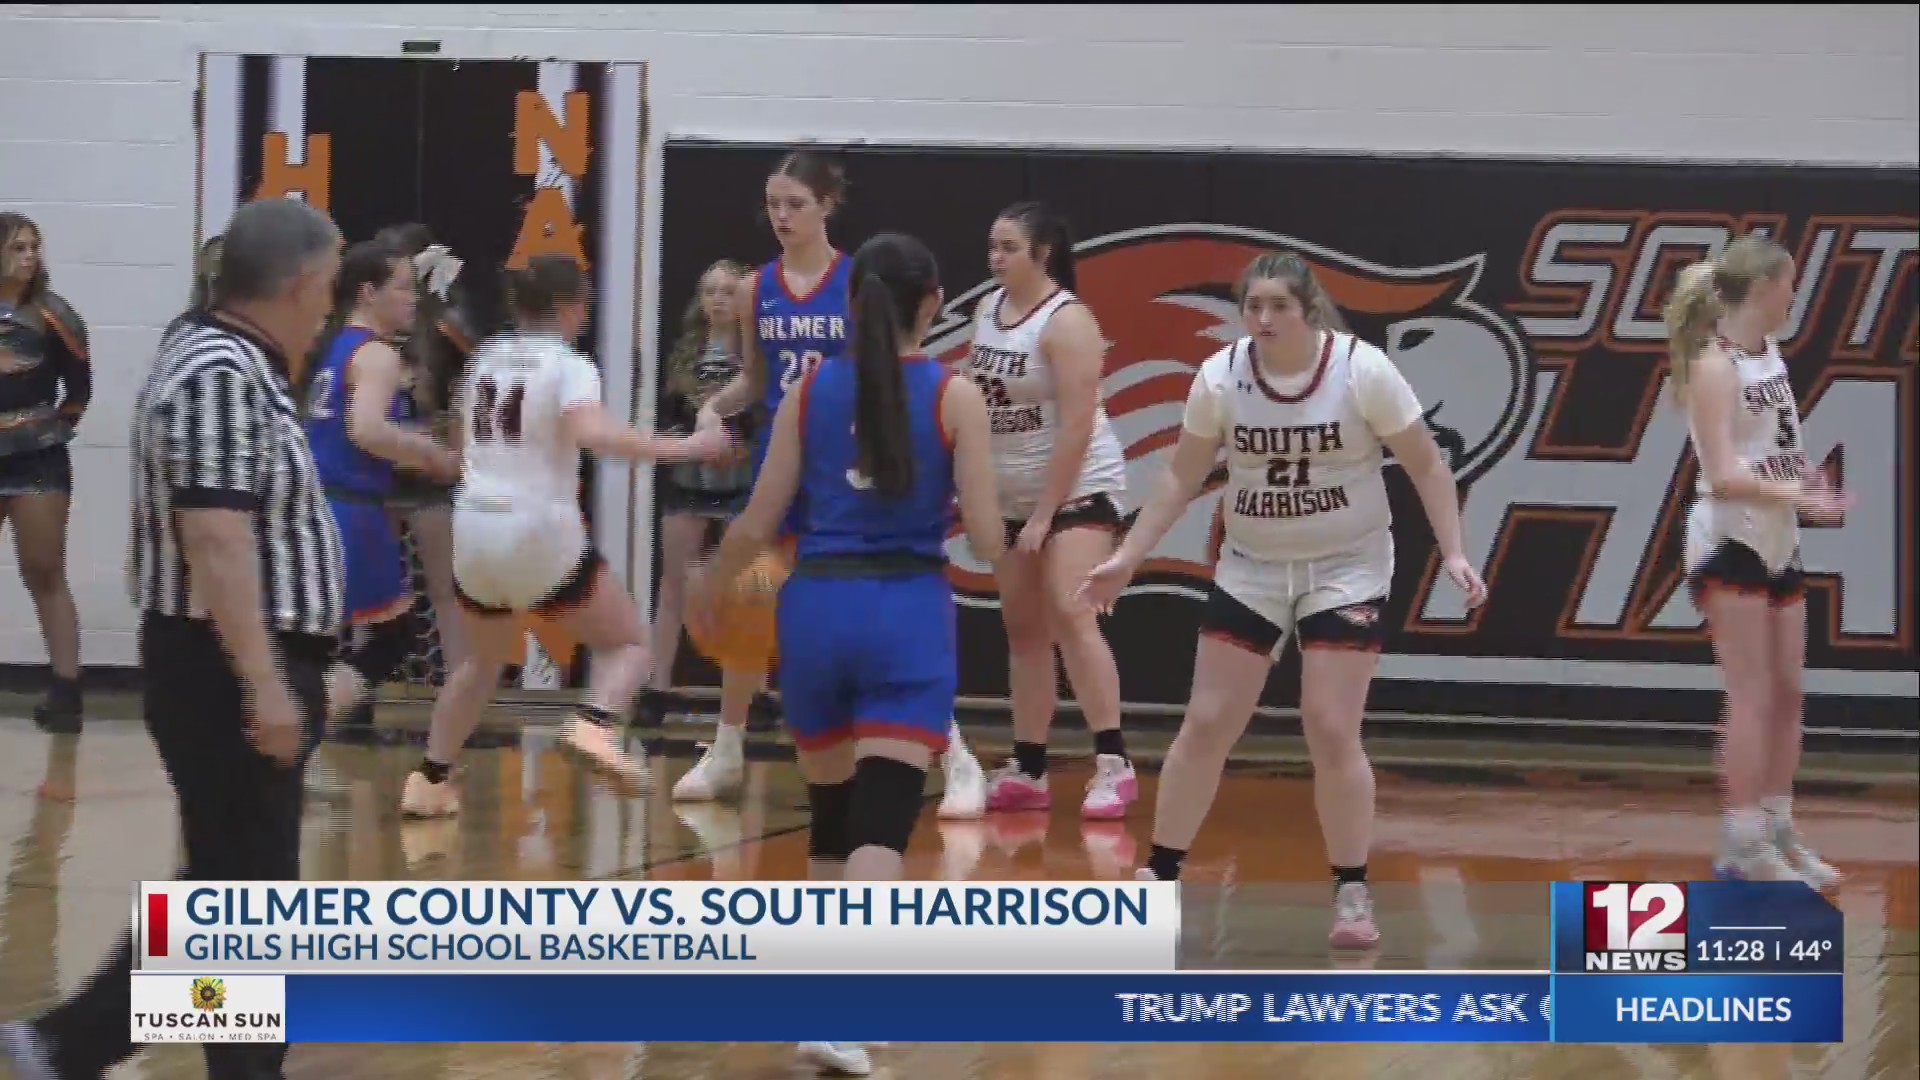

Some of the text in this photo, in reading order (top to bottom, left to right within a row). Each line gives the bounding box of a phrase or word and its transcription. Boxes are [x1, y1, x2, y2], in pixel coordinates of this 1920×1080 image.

[1517, 209, 1919, 355] SOUT
[758, 314, 846, 340] GILMER
[1234, 420, 1343, 455] SOUTH
[1266, 457, 1311, 488] 21
[1234, 486, 1349, 518] HARRISON
